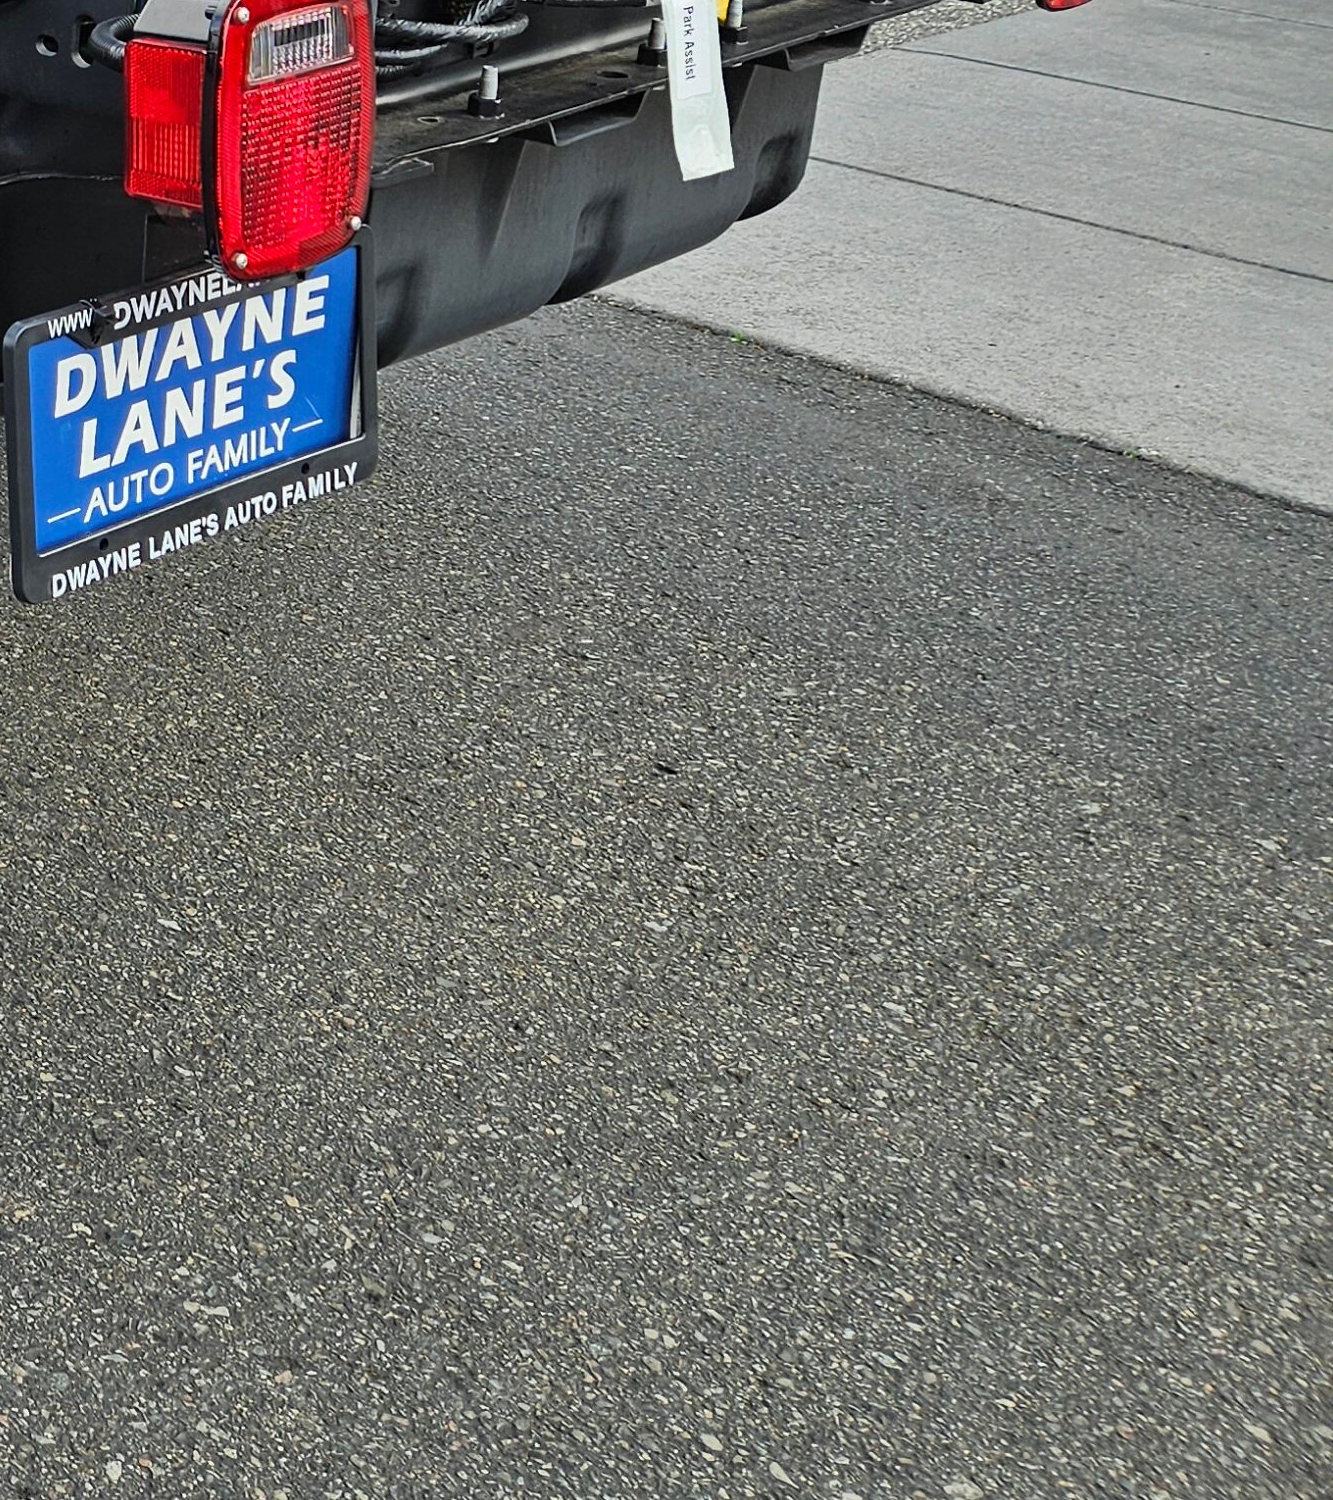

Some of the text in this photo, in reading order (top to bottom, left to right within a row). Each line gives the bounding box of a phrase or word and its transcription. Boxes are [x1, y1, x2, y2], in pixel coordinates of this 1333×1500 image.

[683, 5, 696, 80] Park Assist
[54, 275, 329, 419] DWAYNE
[79, 350, 297, 479] LANE'S
[83, 417, 292, 523] AUTO FAMILY
[52, 461, 359, 597] DWAYNE LANE'S AUTO FAMILY
